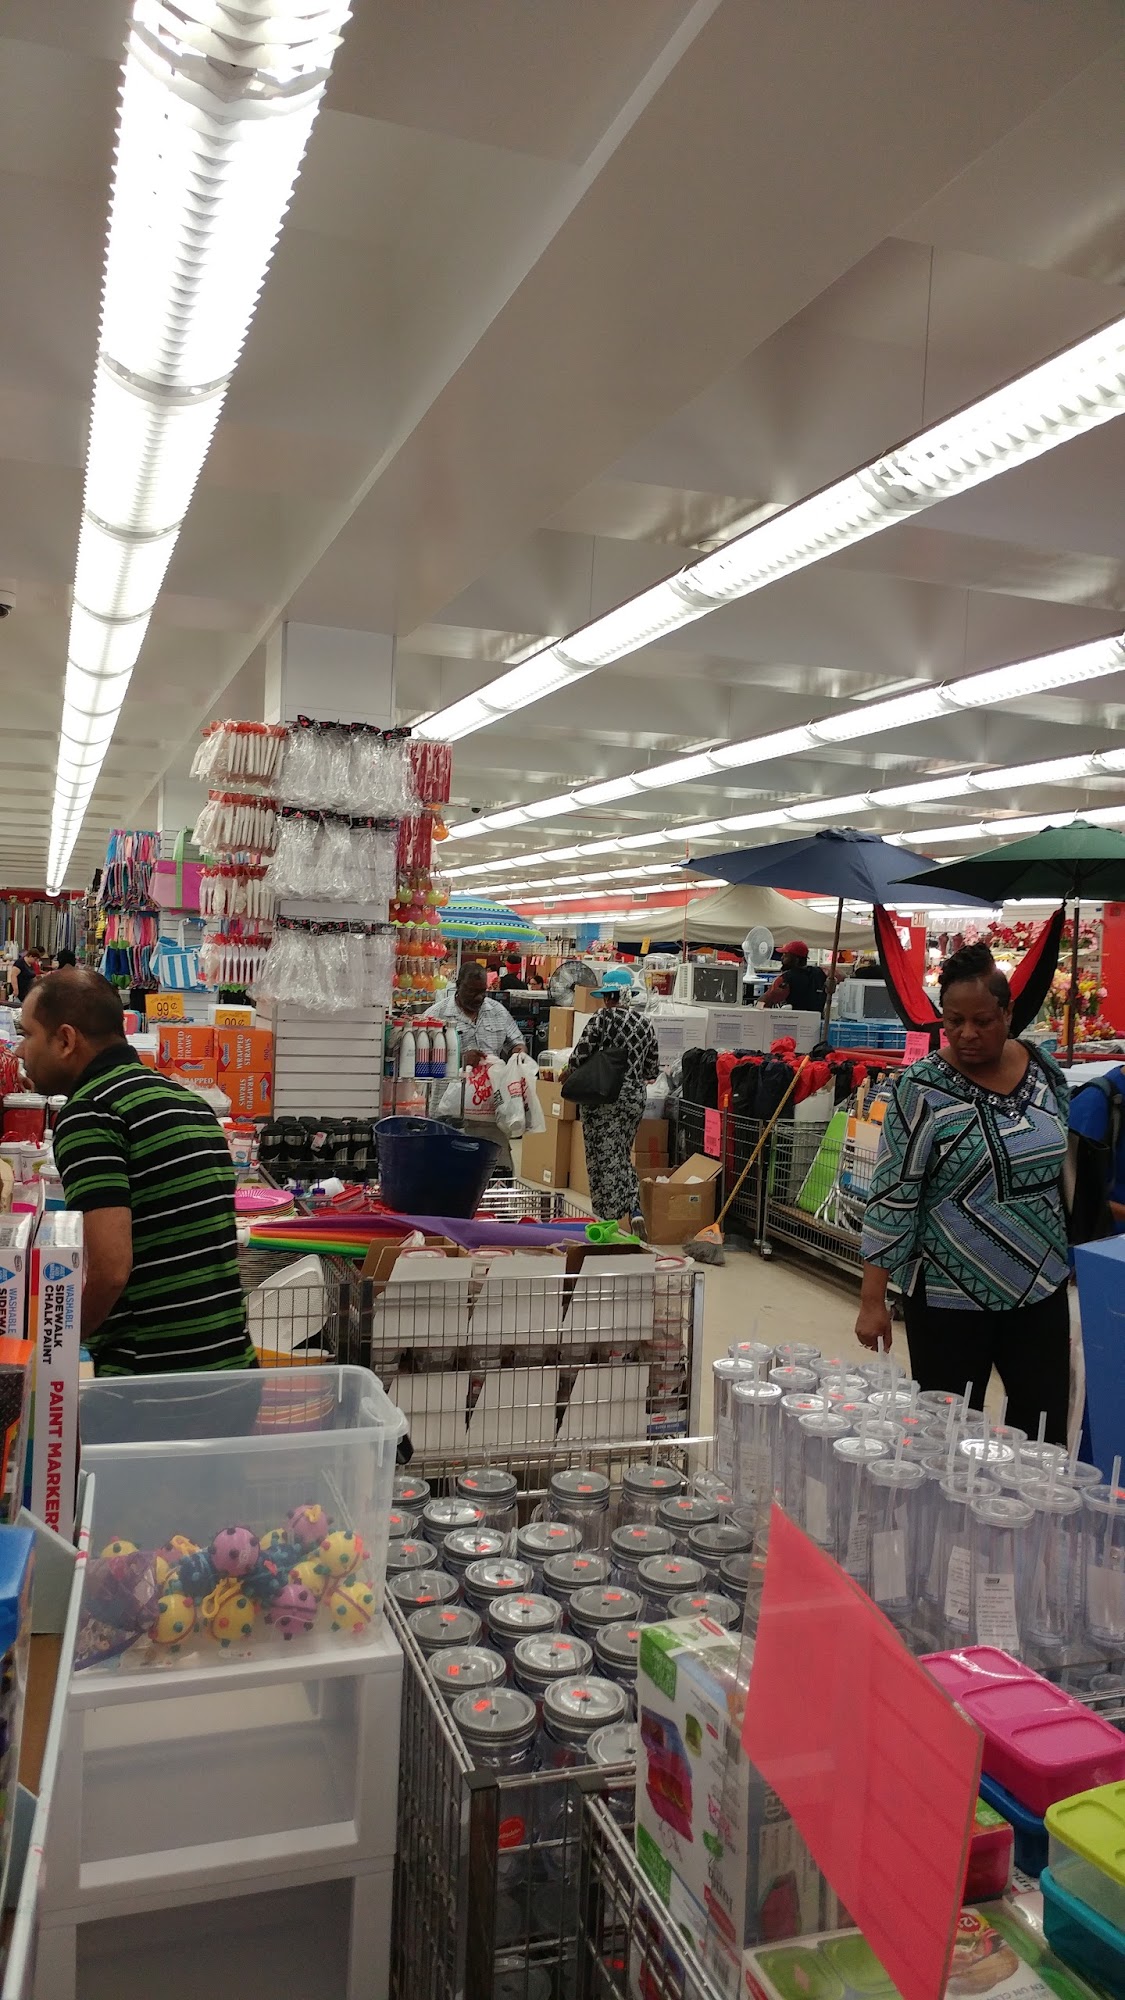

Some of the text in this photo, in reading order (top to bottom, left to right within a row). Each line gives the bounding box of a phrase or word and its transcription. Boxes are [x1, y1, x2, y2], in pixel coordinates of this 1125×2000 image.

[914, 912, 925, 926] EXIT
[177, 1030, 185, 1058] RAPPED
[236, 1034, 244, 1069] WRAPPED
[244, 1038, 252, 1066] STRAWS
[238, 1078, 247, 1106] STRAWS
[246, 1075, 254, 1110] WRAPPED
[7, 1287, 18, 1334] WASHABLE
[42, 1284, 54, 1365] CHALK PAINT
[53, 1284, 65, 1348] SIDEWALK
[65, 1284, 75, 1330] WASHABLE
[48, 1380, 65, 1438] PAINT
